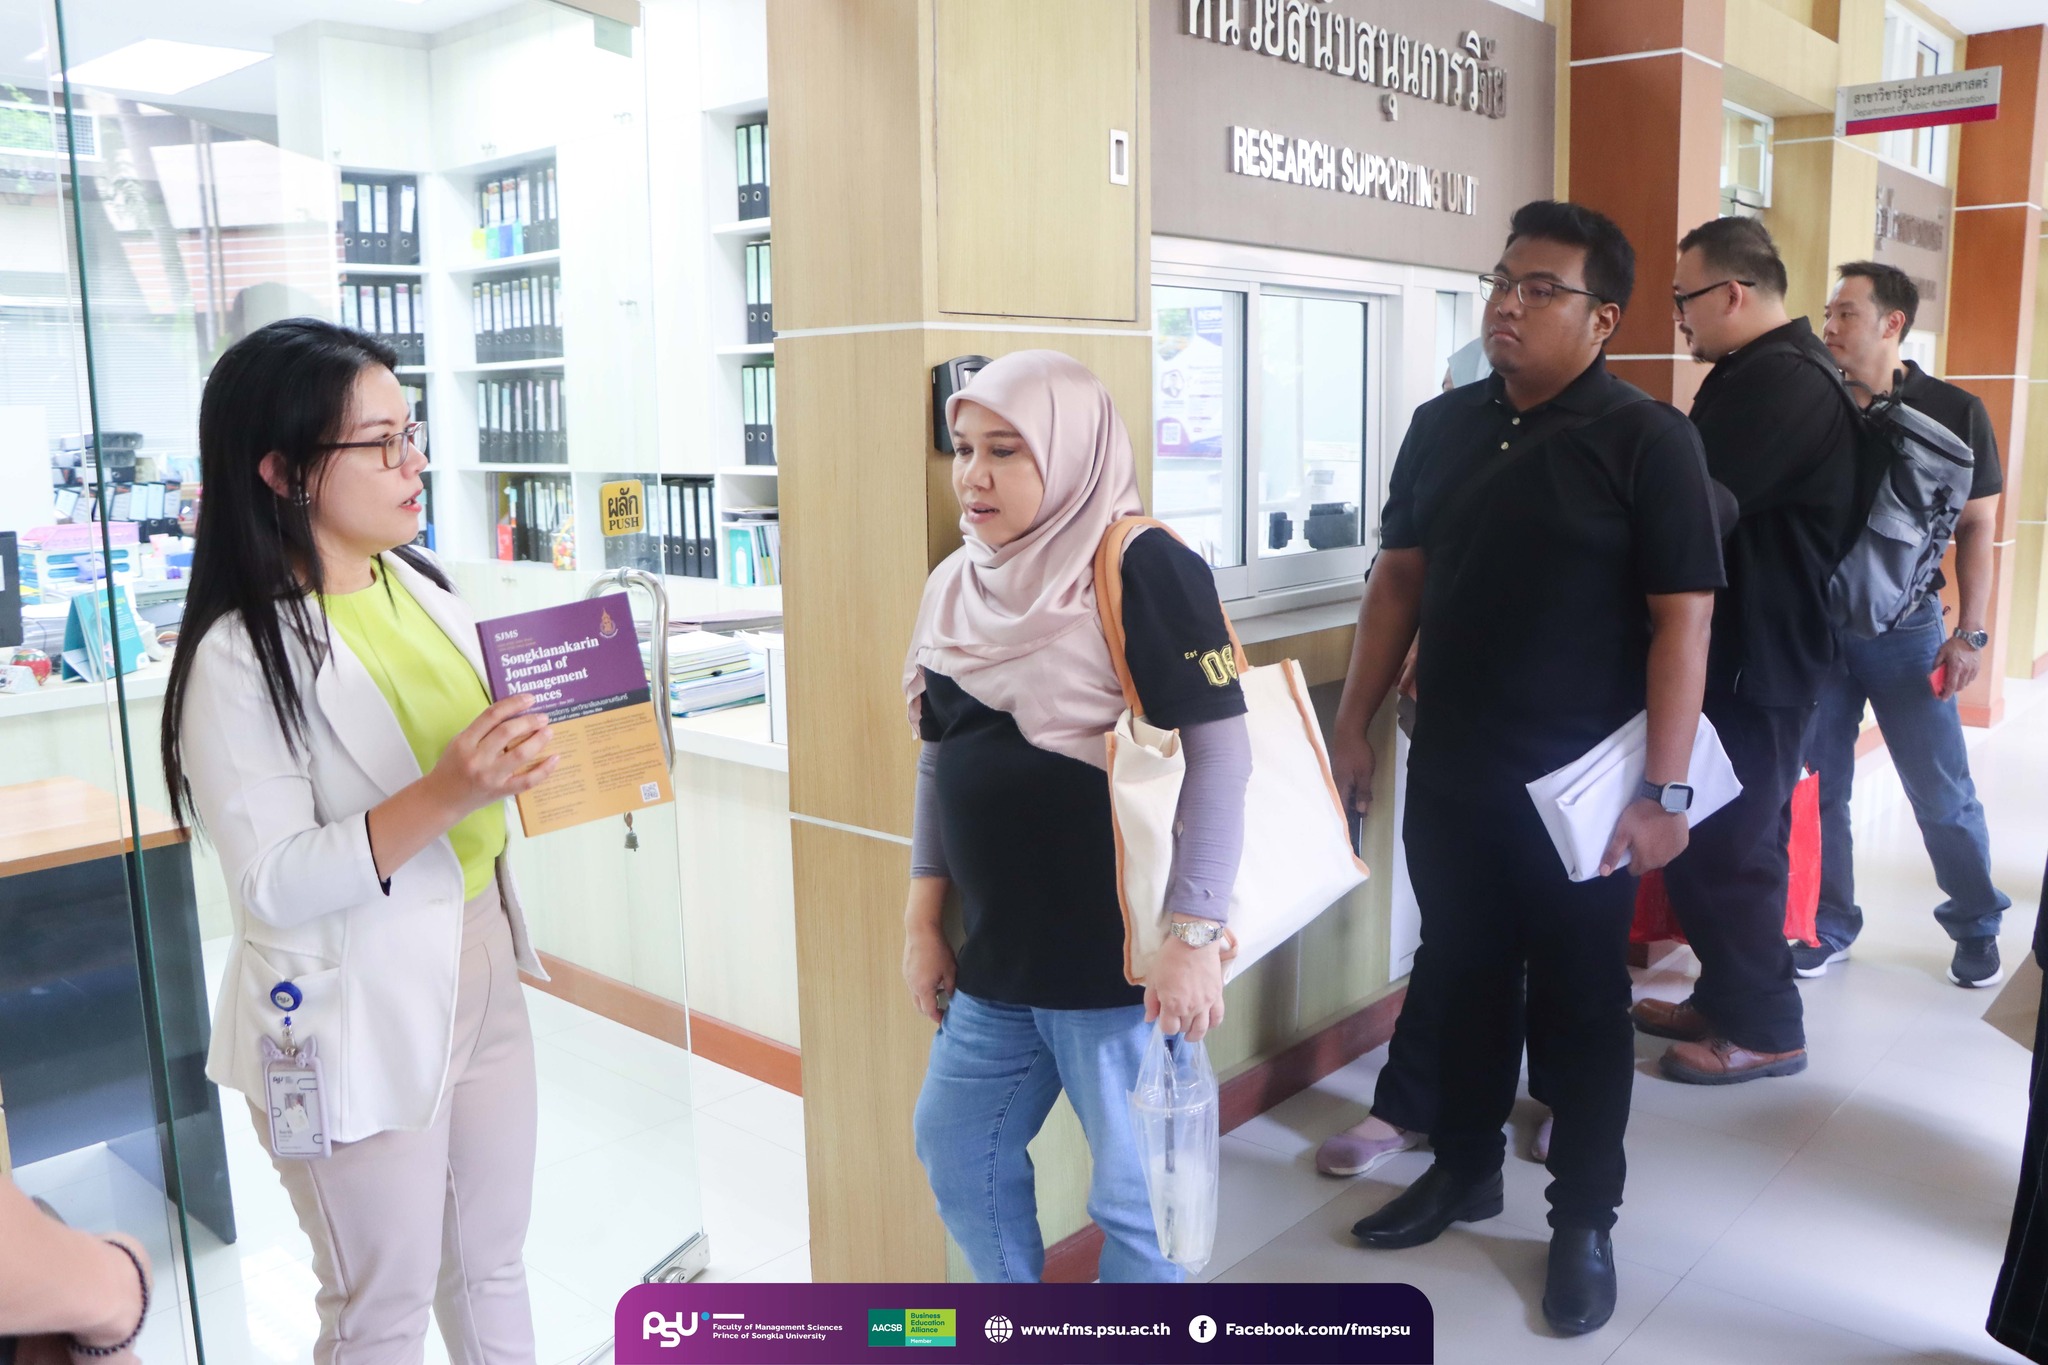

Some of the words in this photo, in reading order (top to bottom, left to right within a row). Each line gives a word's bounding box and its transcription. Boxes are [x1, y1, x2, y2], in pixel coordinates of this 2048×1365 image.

[1183, 0, 1507, 121] หนวยสนบสนุนการวิจัย
[1854, 105, 1896, 117] Department
[1897, 102, 1906, 112] of
[1907, 101, 1930, 111] Public
[1931, 95, 1986, 108] Administration
[1229, 125, 1336, 190] RESEARCH
[1339, 147, 1441, 209] SUPPORTING
[1446, 171, 1480, 216] UNIT
[608, 487, 639, 518] ผลัก
[609, 516, 639, 531] PUSH
[494, 629, 519, 642] SJMS
[501, 636, 600, 667] Songklanakarin
[505, 659, 553, 682] Journal
[555, 655, 568, 670] of
[507, 667, 589, 696] Management
